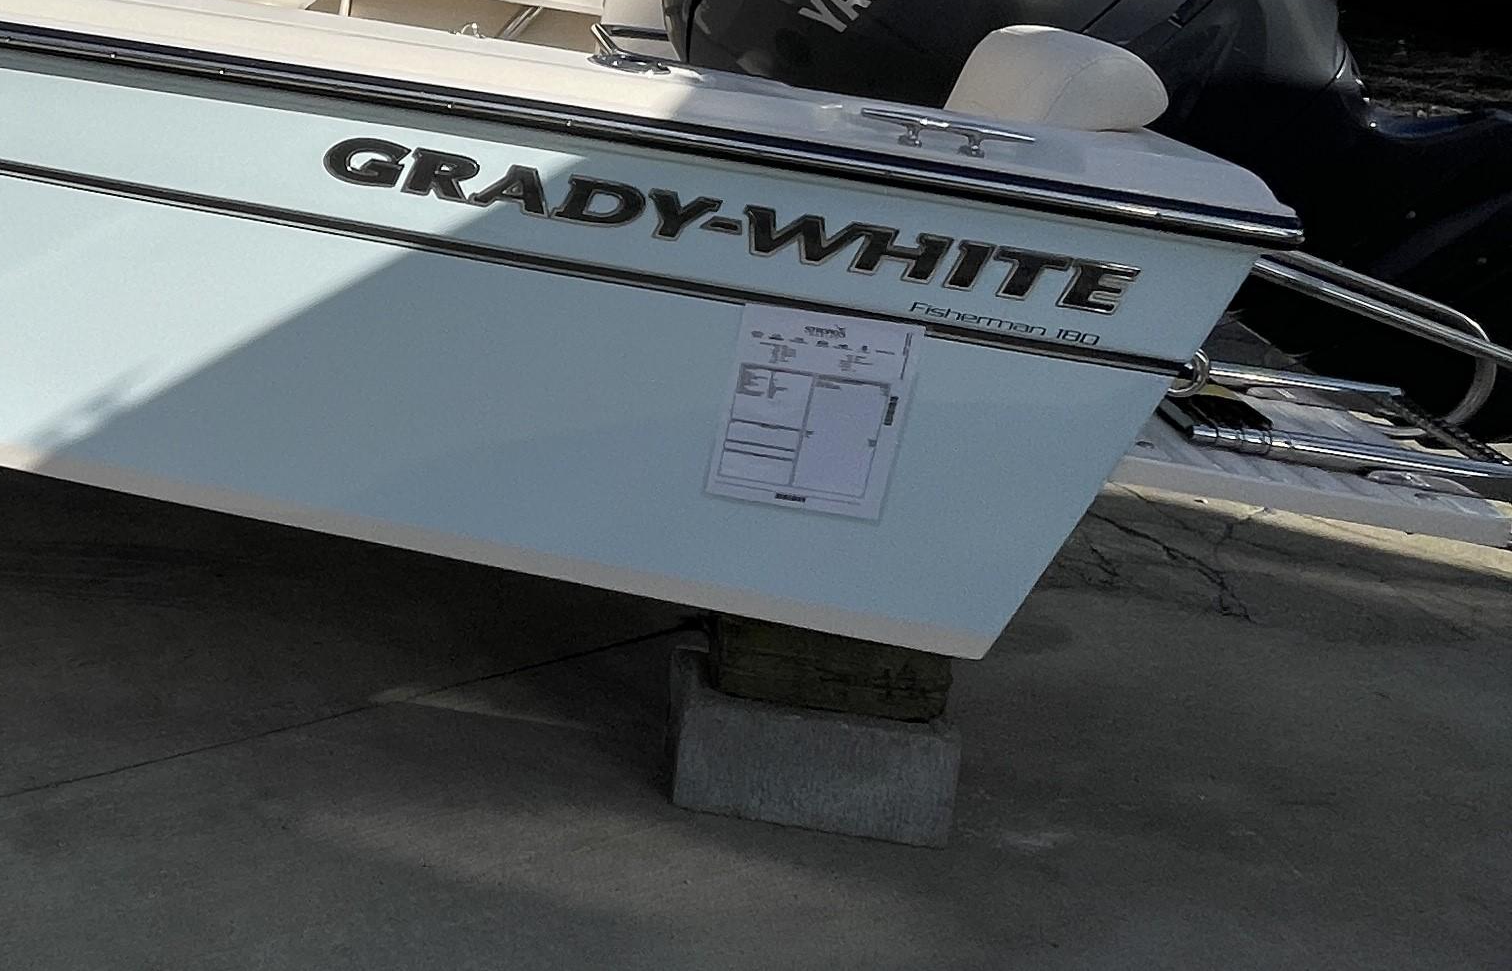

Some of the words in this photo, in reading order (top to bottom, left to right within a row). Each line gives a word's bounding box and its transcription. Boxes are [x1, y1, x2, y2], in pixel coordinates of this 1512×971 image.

[323, 137, 1141, 316] GRADY-WHITE
[909, 301, 1046, 336] Fisherman
[1056, 328, 1100, 346] 180
